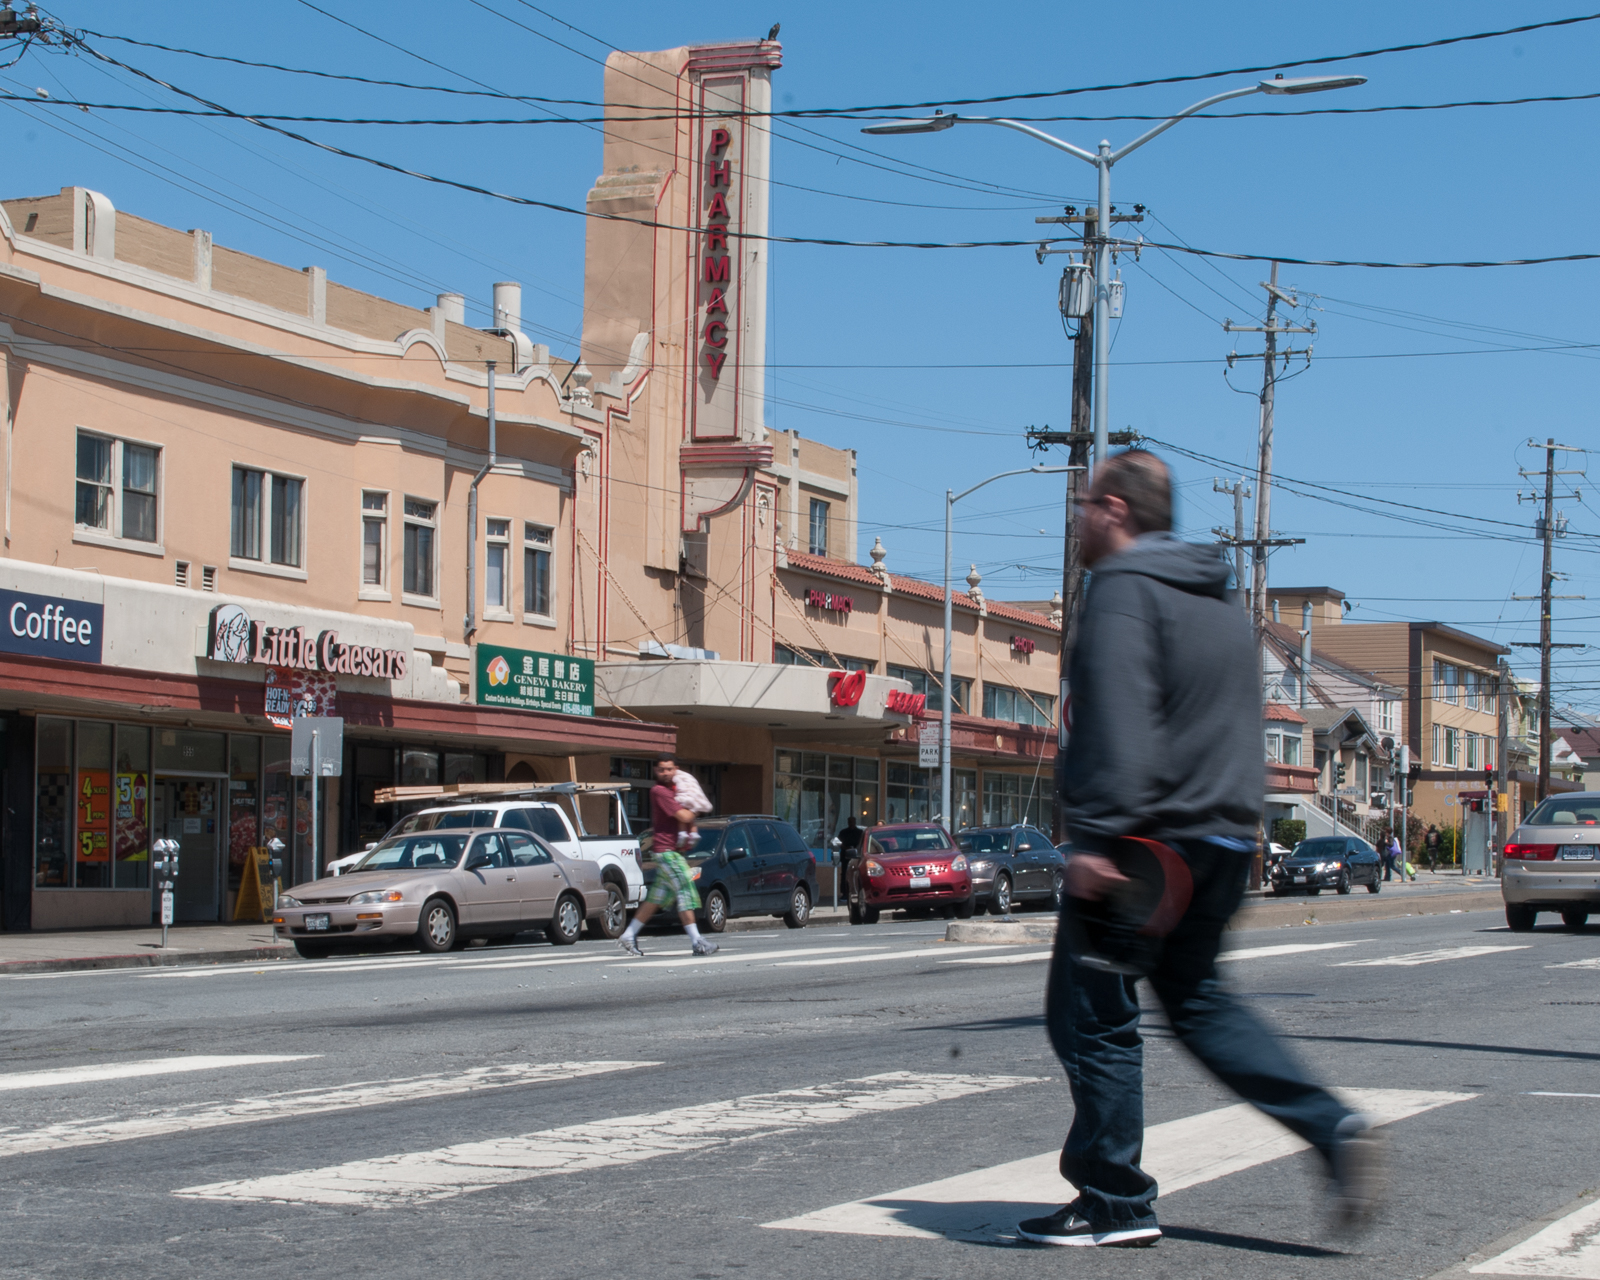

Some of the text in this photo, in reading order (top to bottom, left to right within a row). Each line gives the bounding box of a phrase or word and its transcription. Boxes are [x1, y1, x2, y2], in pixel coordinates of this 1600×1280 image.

[705, 129, 731, 380] PHARMACY
[810, 589, 854, 613] PHARMACY
[10, 602, 92, 645] Coffee
[253, 620, 407, 680] Little Caesars
[523, 656, 580, 681] 金屋餅店
[266, 687, 290, 702] HOT-N-
[513, 674, 587, 692] GENEVA BAKERY
[265, 700, 290, 713] READY
[921, 748, 938, 756] PARK
[82, 777, 92, 798] 4
[117, 777, 131, 802] $5
[92, 811, 105, 819] PEPSI
[79, 832, 93, 856] $5
